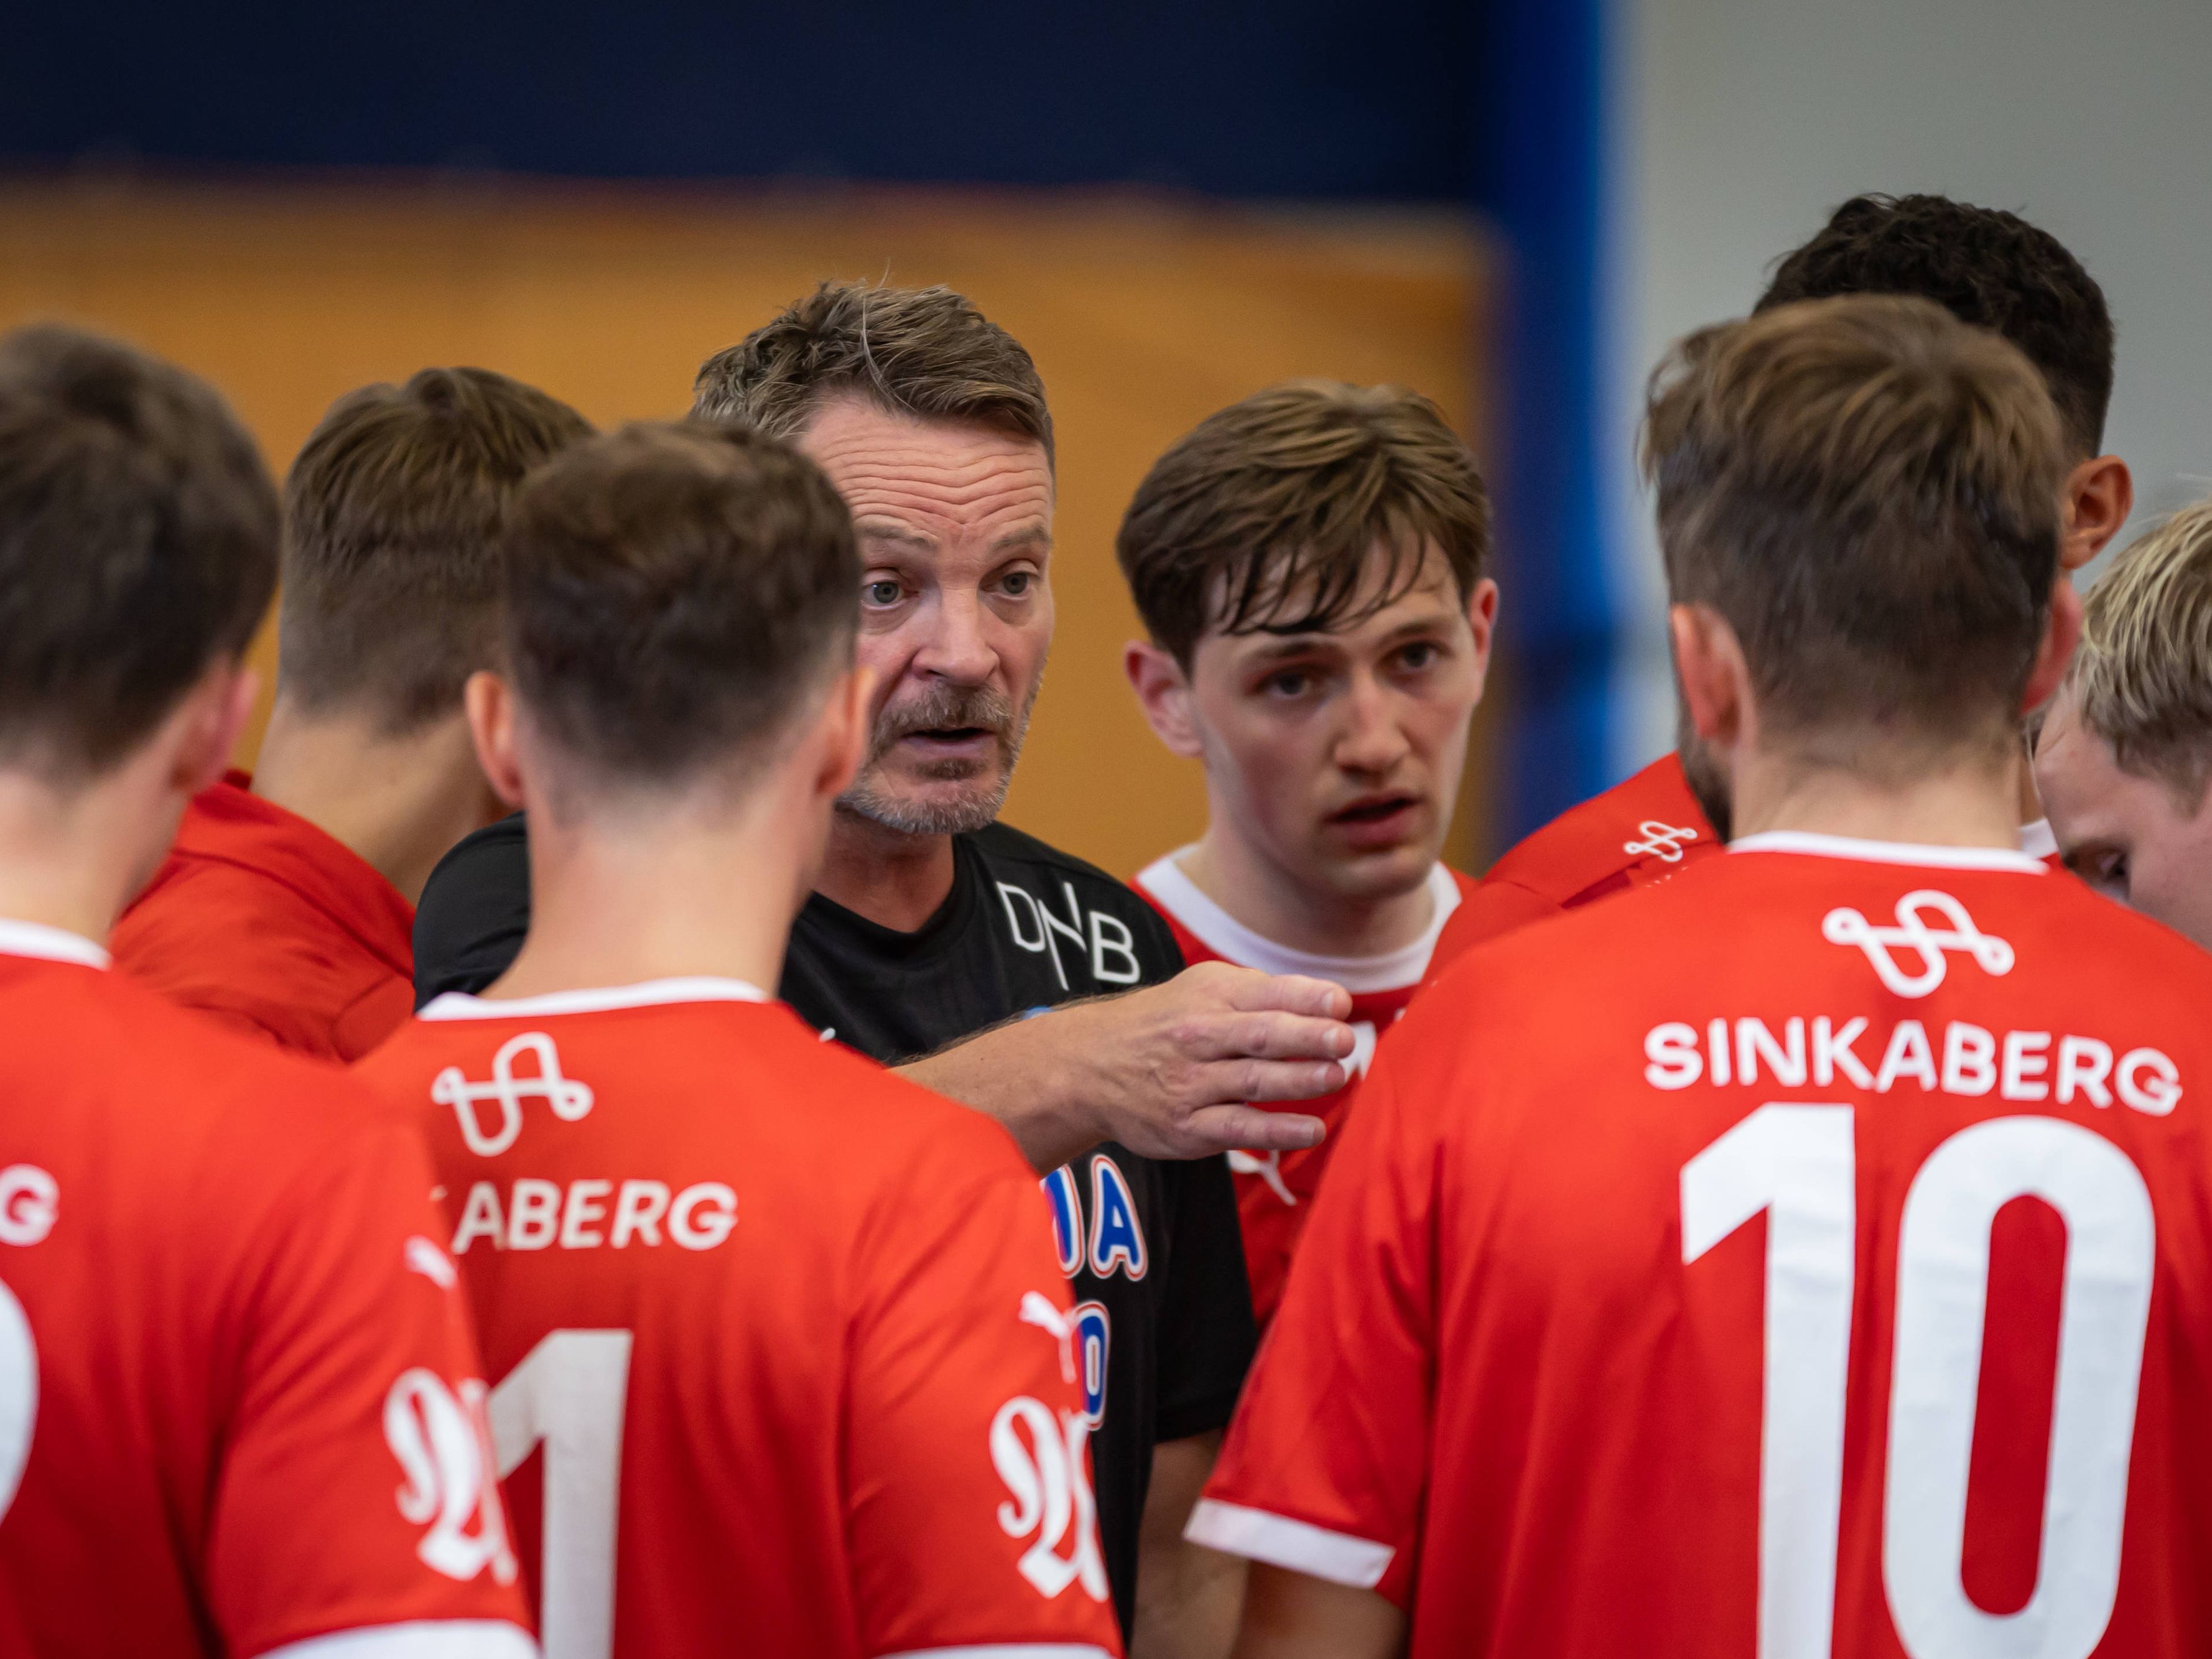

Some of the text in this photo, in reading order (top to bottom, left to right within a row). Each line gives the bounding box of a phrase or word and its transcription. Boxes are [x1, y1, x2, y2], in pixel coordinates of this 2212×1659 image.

[997, 881, 1140, 992] DNB
[1643, 1016, 2182, 1117] SINKABERG
[430, 1178, 738, 1255] ABERG
[1680, 1101, 2156, 1659] 10
